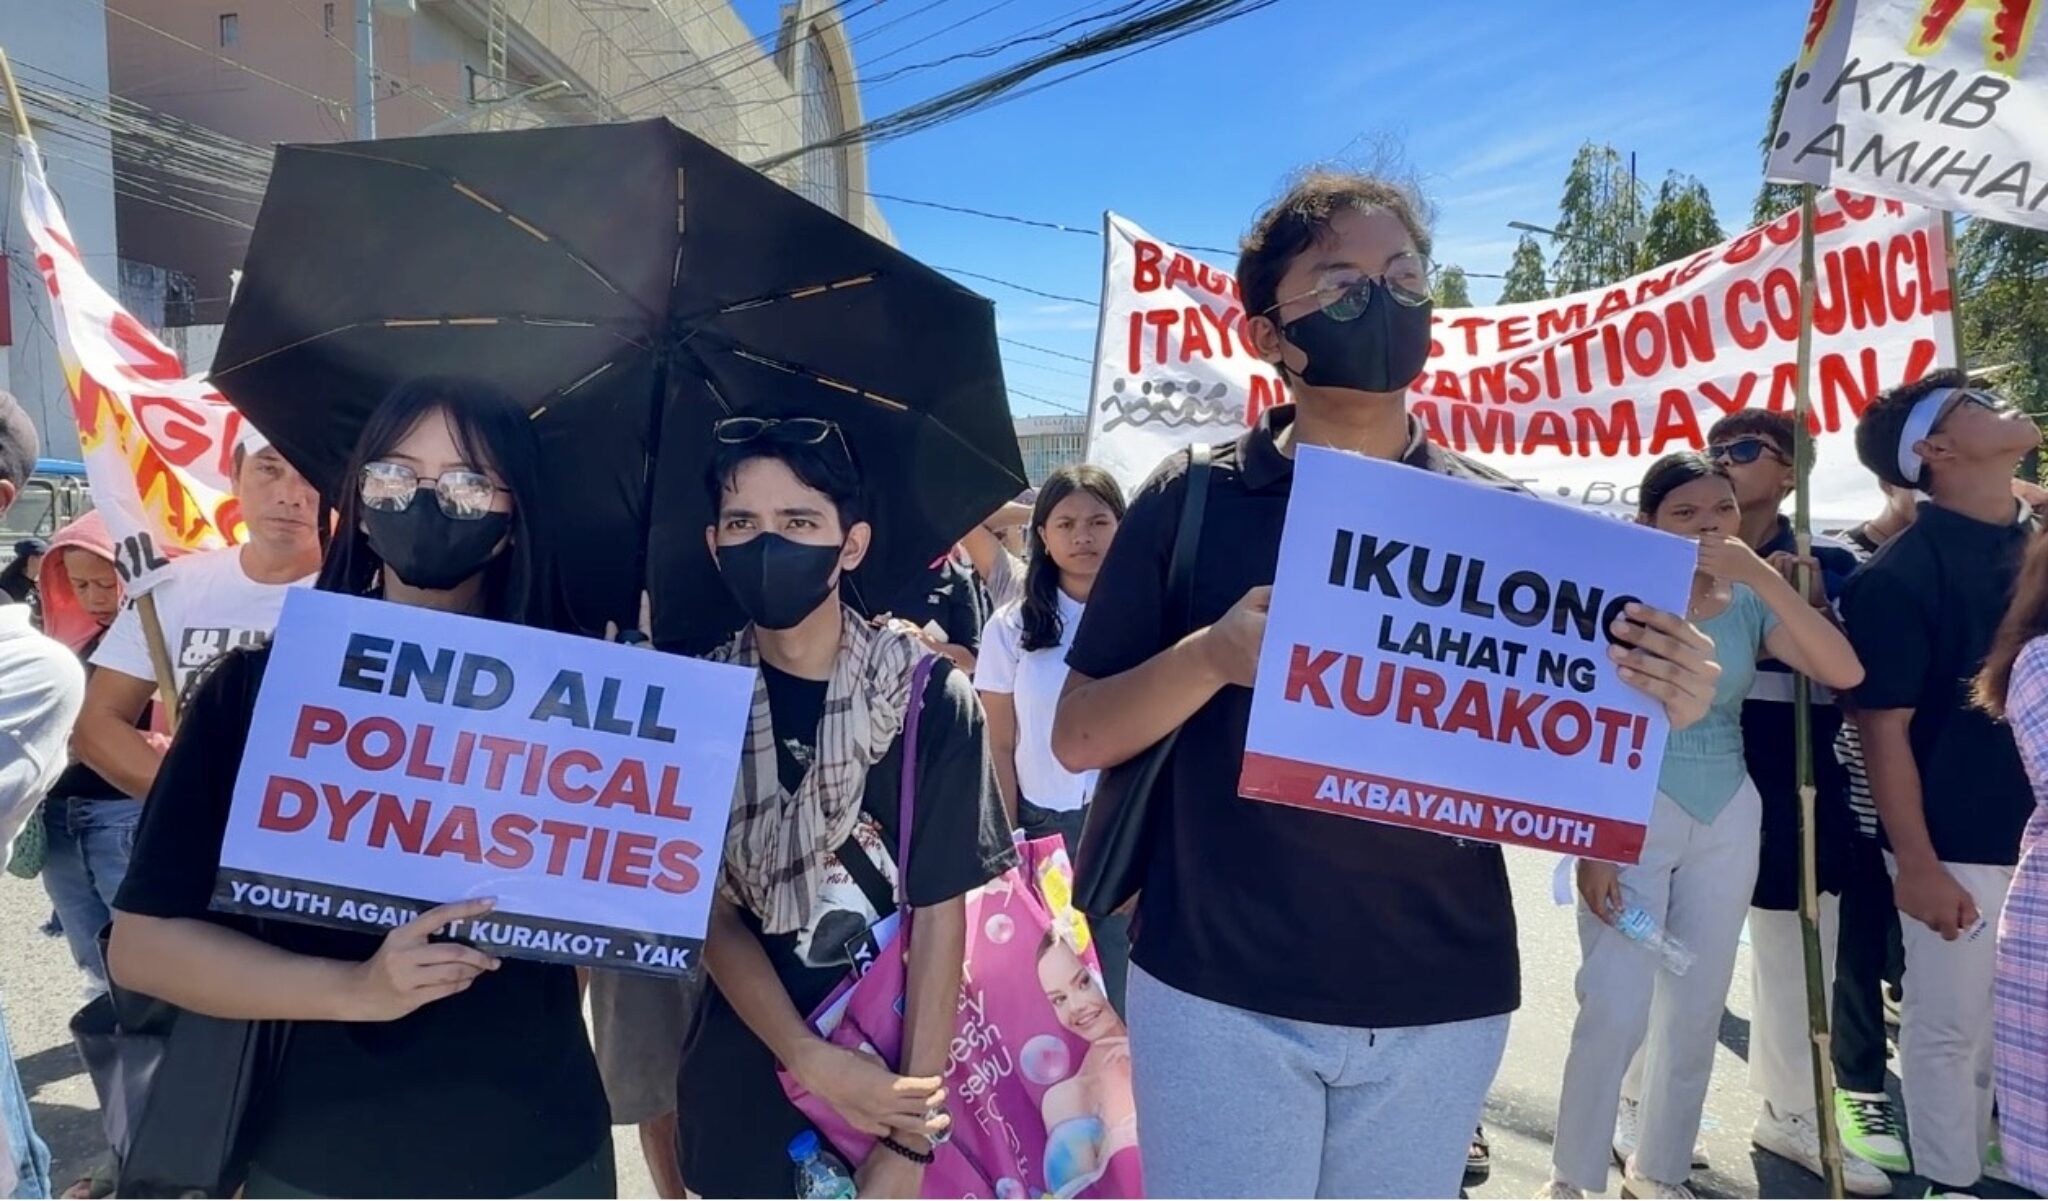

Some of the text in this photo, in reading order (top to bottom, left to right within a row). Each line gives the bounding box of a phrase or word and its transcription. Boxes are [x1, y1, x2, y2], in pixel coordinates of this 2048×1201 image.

[1822, 57, 2011, 129] KMB
[1134, 239, 1241, 301] BAG
[1410, 294, 1715, 405] ANSITION
[338, 632, 516, 712] END
[529, 668, 678, 744] ALL
[1377, 614, 1597, 694] LAHAT NG
[1283, 643, 1650, 771] KURAKOT!
[289, 704, 694, 822] POLITICAL
[1315, 774, 1596, 848] AKBAYAN YOUTH
[257, 774, 704, 895] DYNASTIES
[231, 880, 333, 917] YOUTH
[336, 899, 464, 939] AGAIT
[469, 919, 611, 959] KURAKOT
[633, 942, 691, 970] YAK
